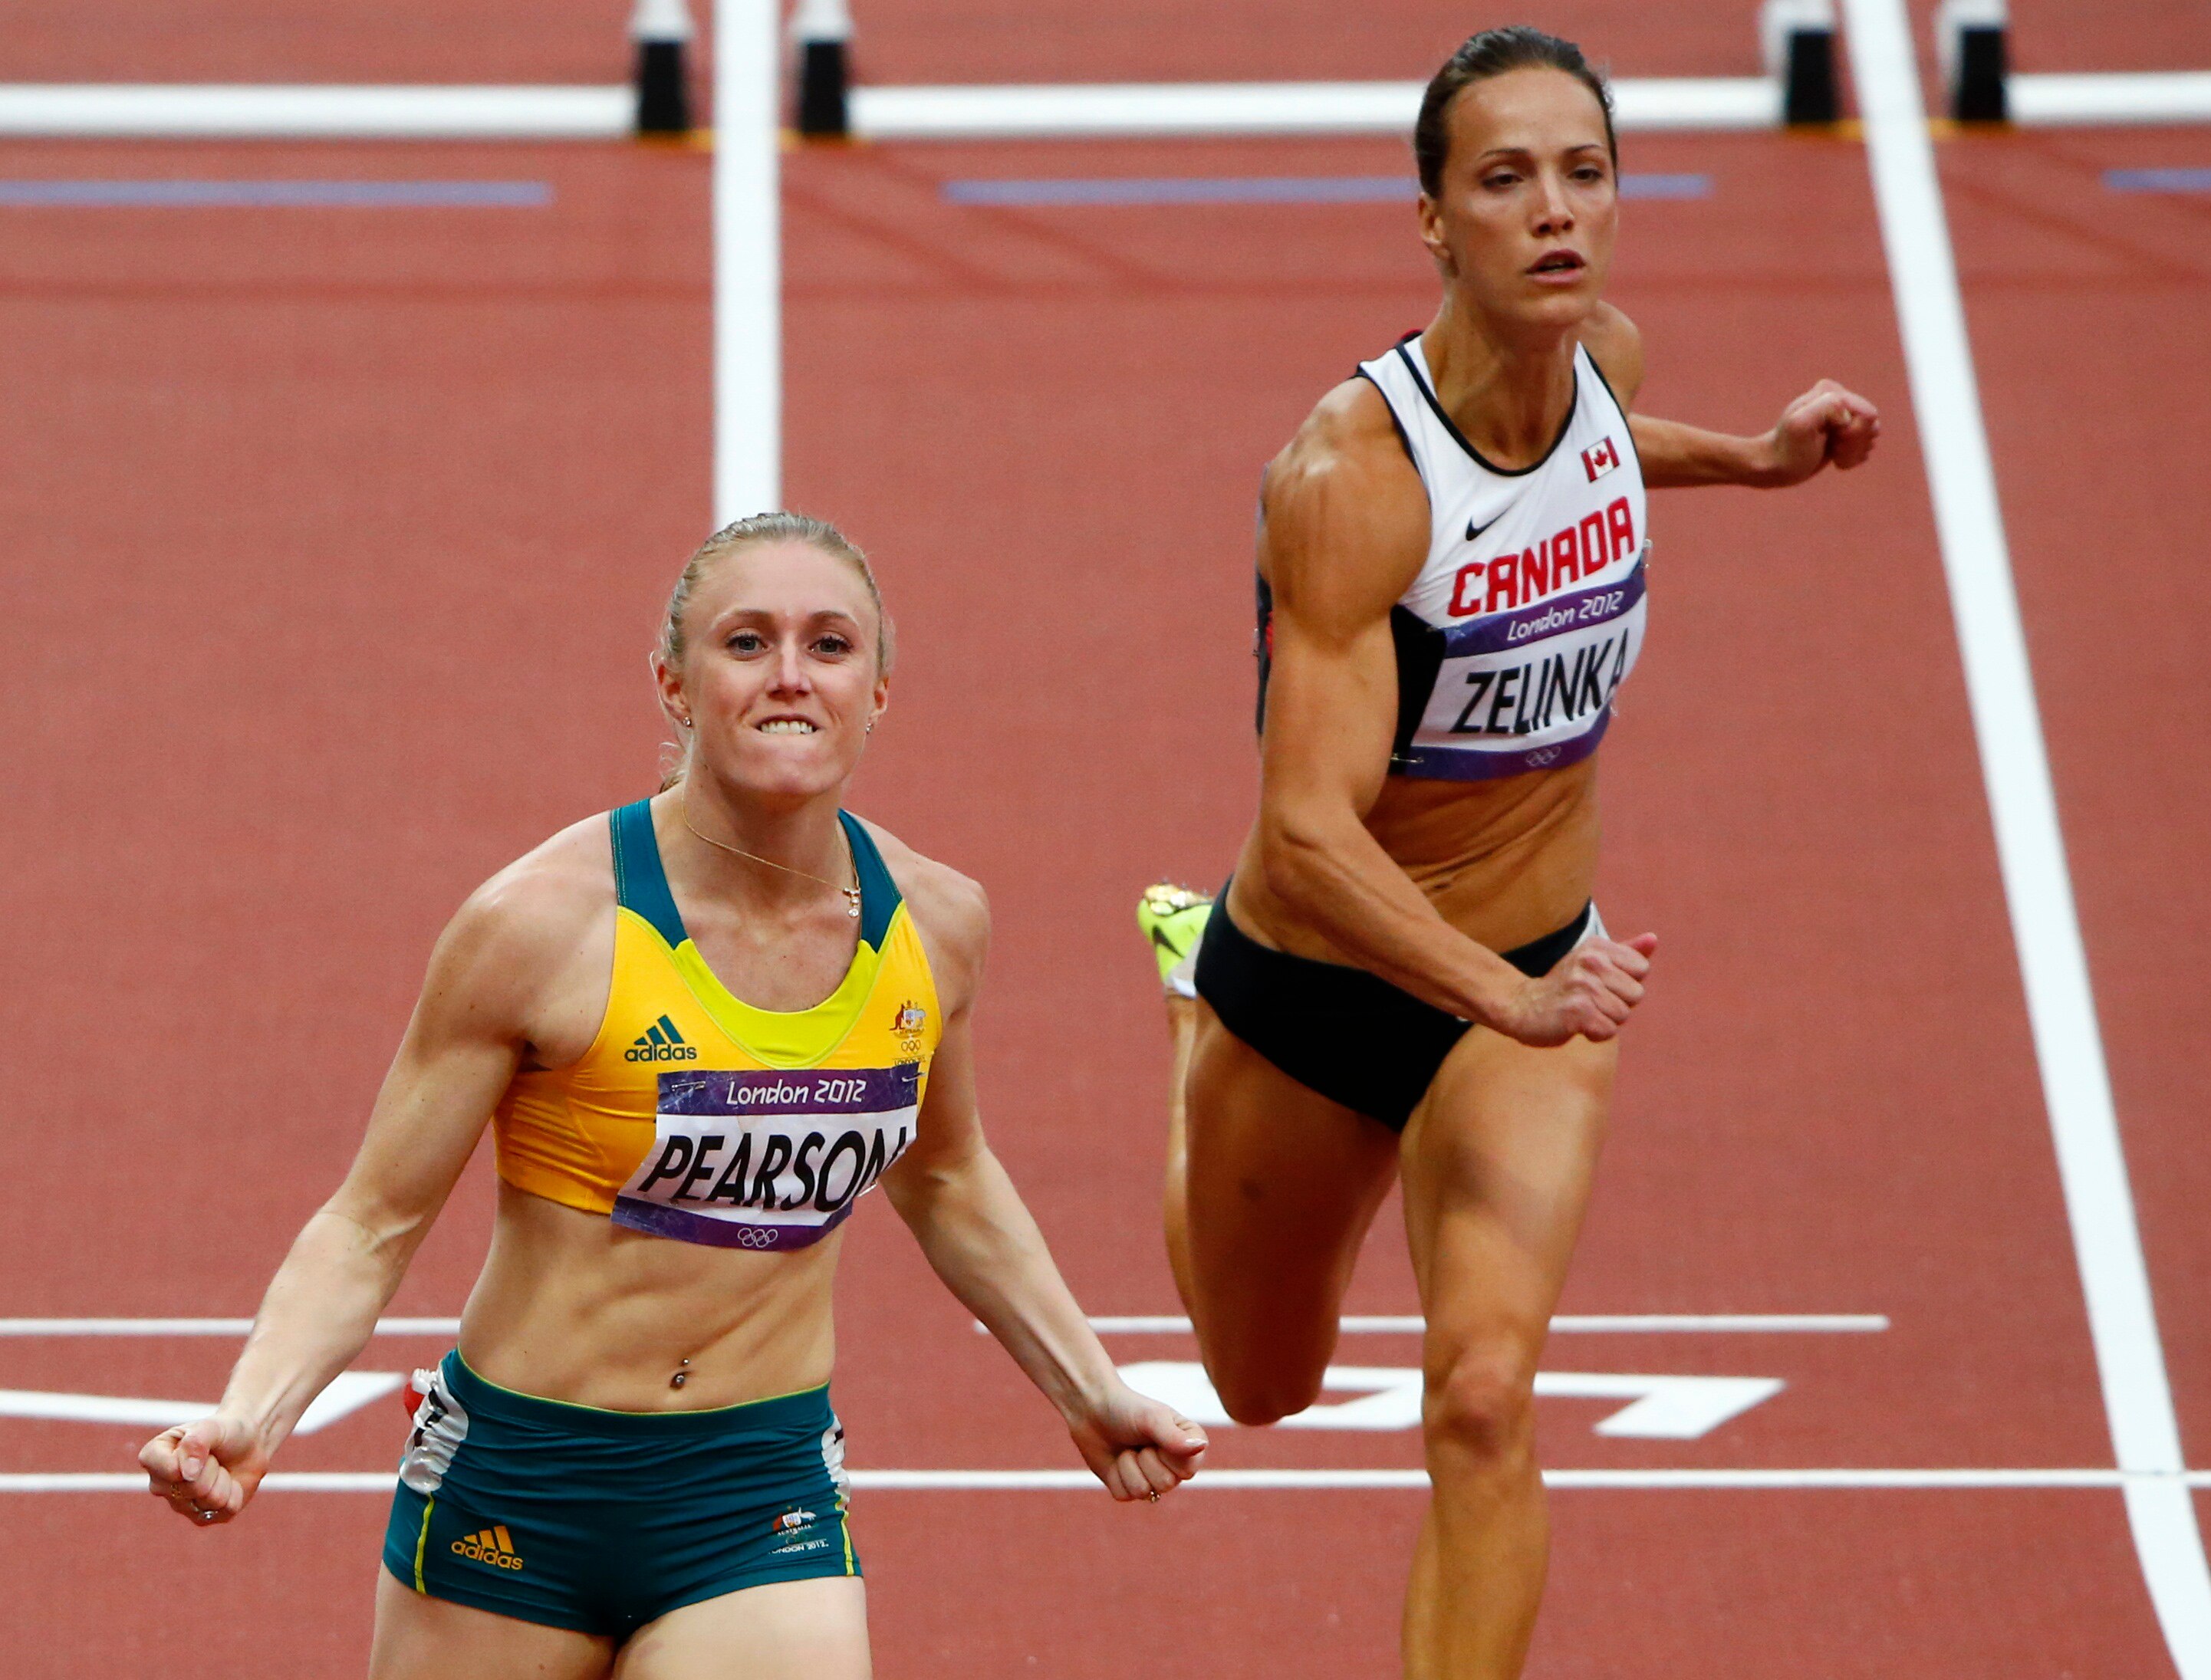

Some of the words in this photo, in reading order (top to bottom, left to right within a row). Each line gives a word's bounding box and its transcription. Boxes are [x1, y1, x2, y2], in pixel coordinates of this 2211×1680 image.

[1447, 496, 1635, 617] CANADA
[1507, 608, 1574, 642] London
[1579, 591, 1624, 619] 2012
[1450, 627, 1628, 735] ZELINKA
[624, 1044, 697, 1062] adidas
[726, 1078, 808, 1105] London
[813, 1079, 867, 1103] 2012
[451, 1541, 523, 1570] adidas
